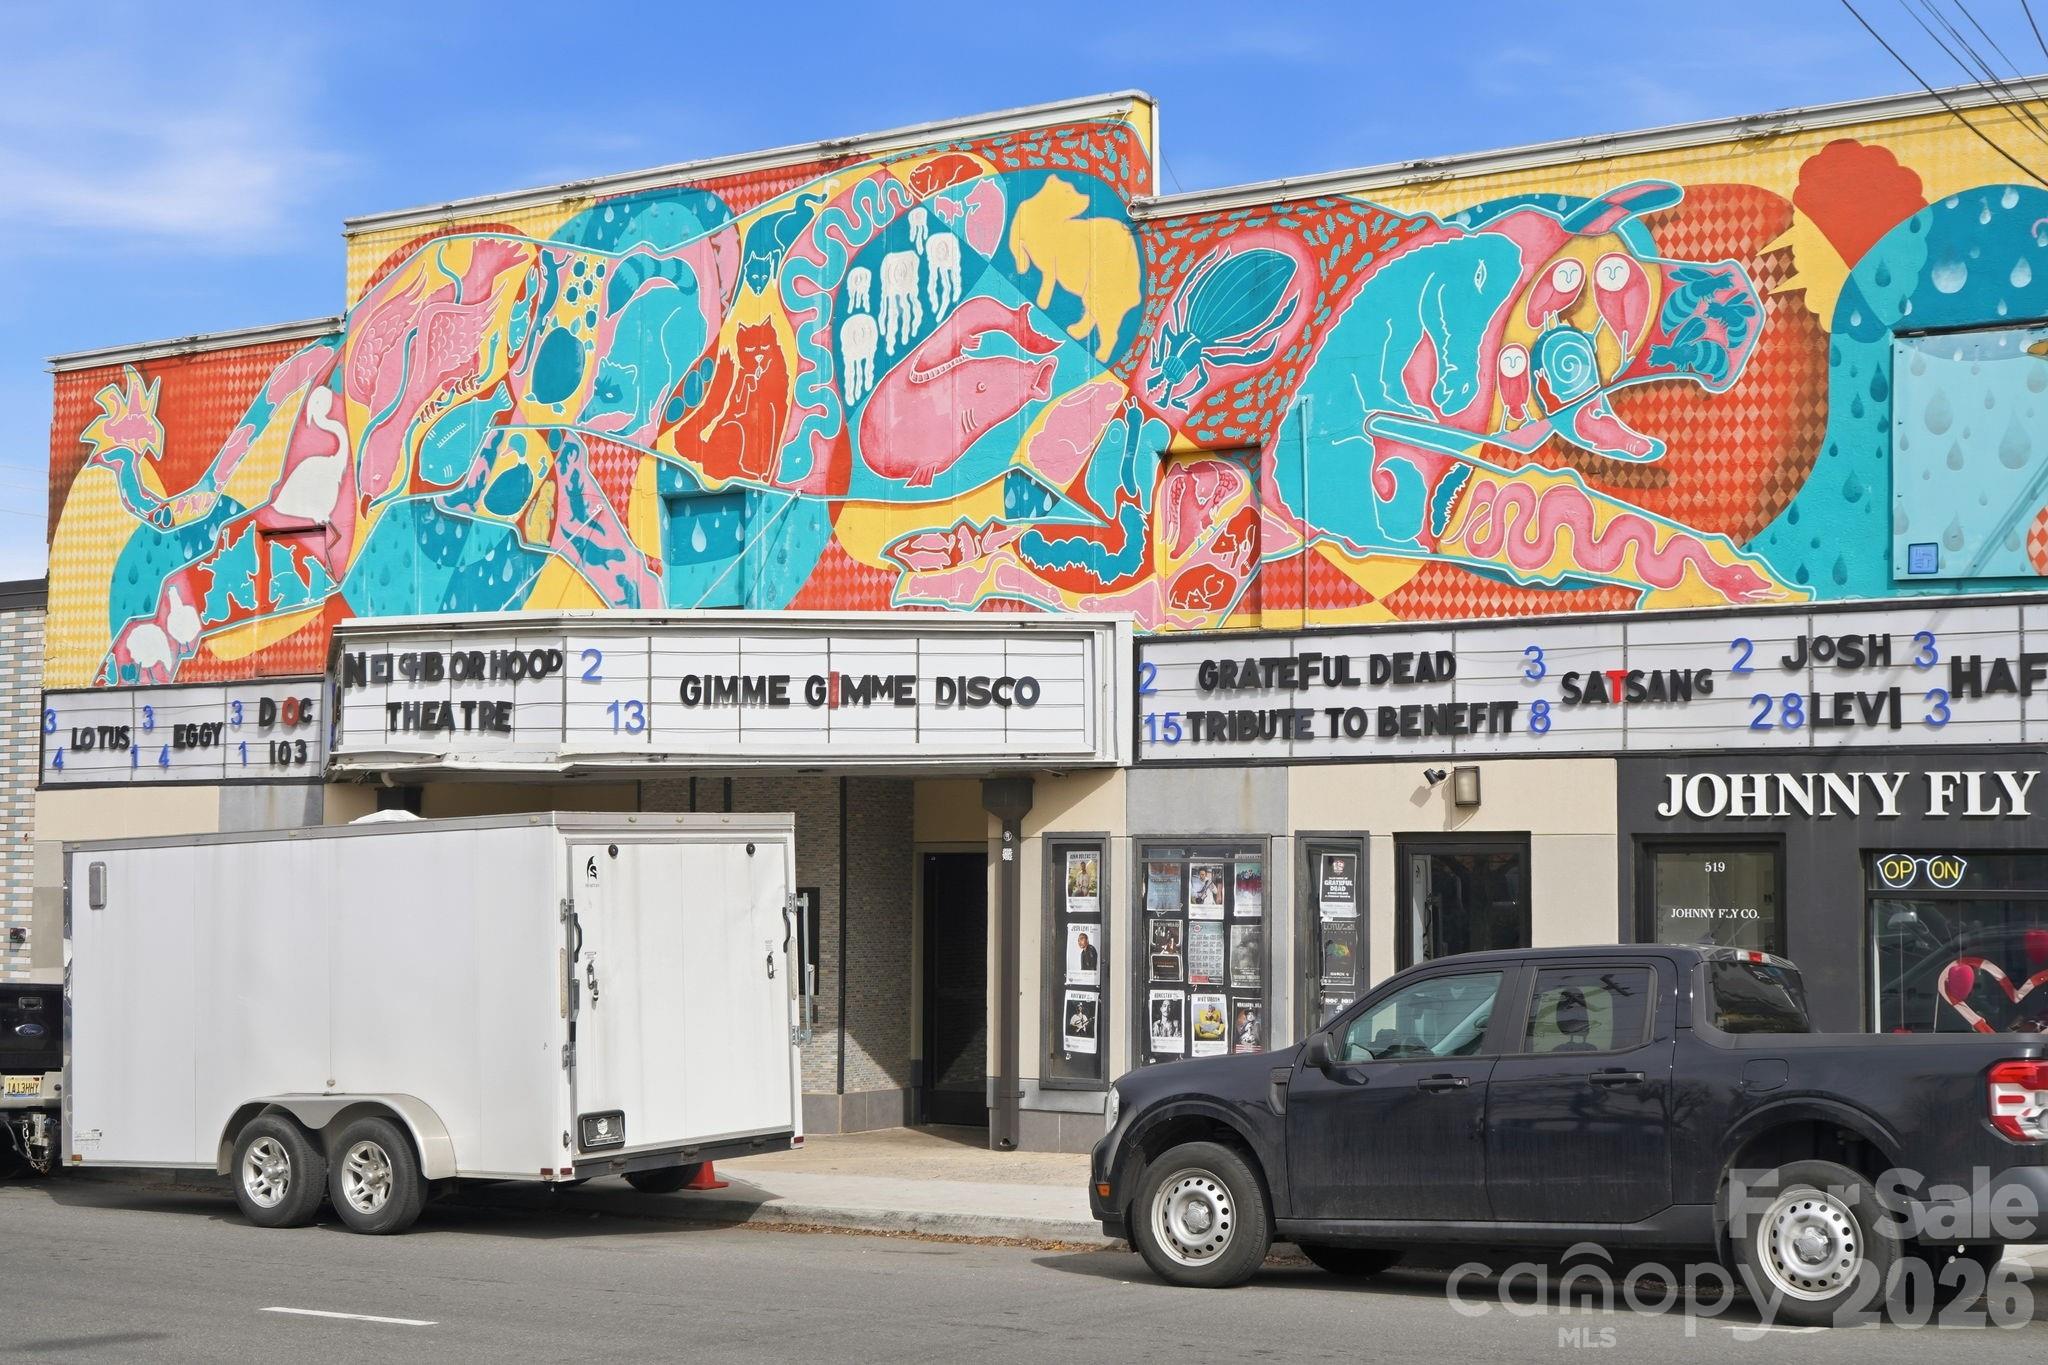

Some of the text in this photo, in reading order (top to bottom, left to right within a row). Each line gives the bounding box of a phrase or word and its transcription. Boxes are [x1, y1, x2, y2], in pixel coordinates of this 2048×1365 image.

[580, 648, 603, 682] 2
[1524, 645, 1546, 680] 3
[1731, 637, 1754, 673] 2
[1781, 633, 1891, 671] JOSH
[1914, 631, 1939, 669] 3
[344, 648, 563, 688] NEIGHBORHOOD
[1138, 662, 1158, 695] 2
[1200, 651, 1456, 691] GRATEFUL DEAD
[680, 671, 1041, 710] GIMME GIMME DISCO
[1561, 668, 1713, 704] SATSANG
[43, 708, 57, 734] 3
[143, 705, 154, 730] 3
[231, 700, 243, 725] 3
[259, 696, 313, 727] DOC
[386, 701, 513, 732] THEATRE
[606, 700, 645, 735] 13
[1186, 701, 1518, 742] TRIBUTE TO BENEFIT
[1530, 699, 1551, 734] 8
[1750, 693, 1804, 730] 28
[1811, 687, 1901, 730] LEVI
[1925, 688, 1951, 727] 3
[71, 725, 131, 751] LOTUS
[173, 721, 223, 748] EGGY
[1144, 711, 1182, 745] 15
[52, 747, 64, 770] 4
[239, 741, 247, 766] 1
[269, 739, 307, 765] 103
[1657, 771, 2041, 818] JOHNNY FLY
[1705, 862, 1726, 872] 519
[1884, 861, 1960, 880] OP ON
[1671, 908, 1715, 919] JOHNNY
[1740, 908, 1760, 919] CO.
